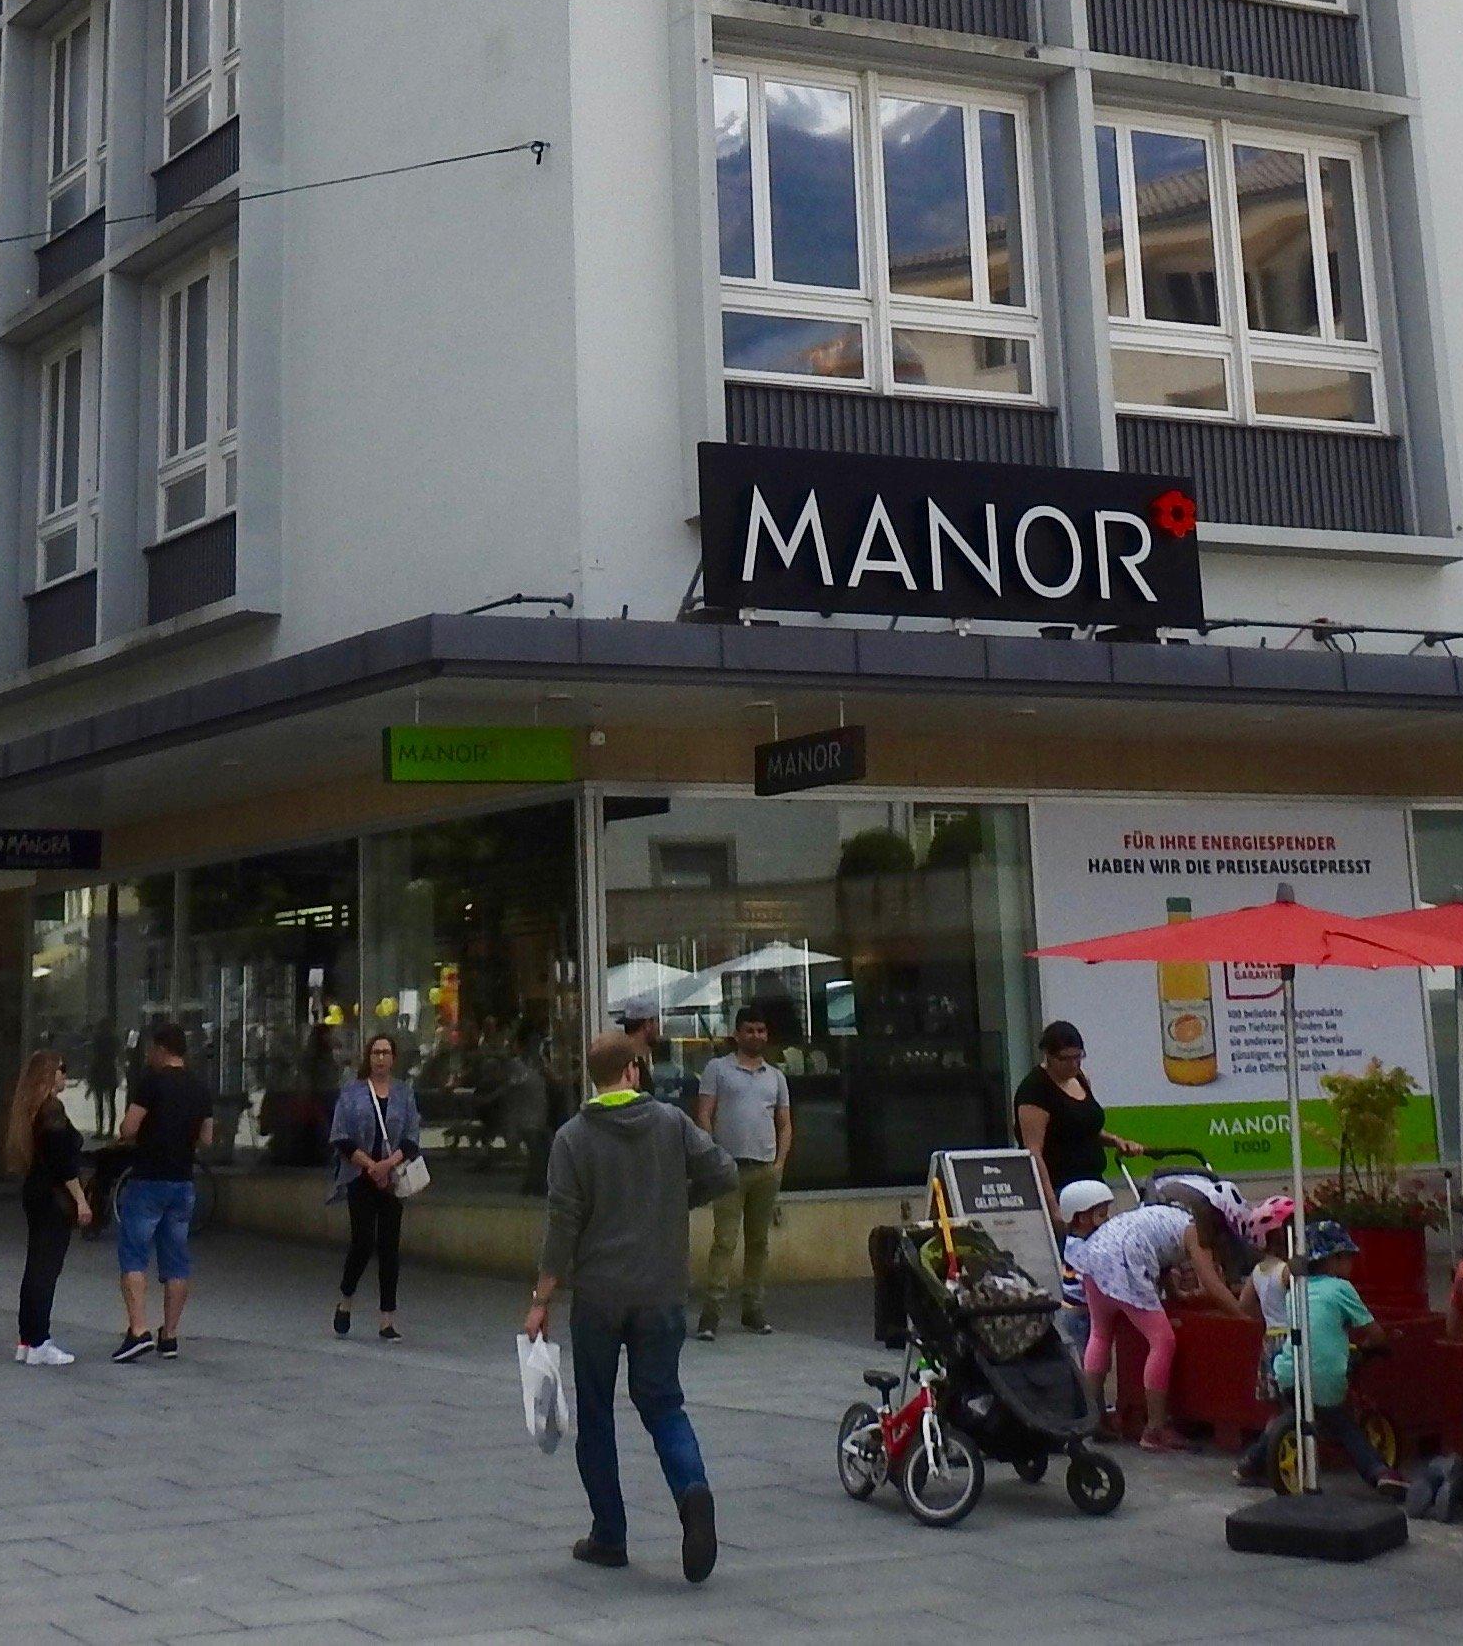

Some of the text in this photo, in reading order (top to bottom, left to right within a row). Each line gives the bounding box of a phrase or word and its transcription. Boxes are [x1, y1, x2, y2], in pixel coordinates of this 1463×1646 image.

[742, 483, 1159, 602] MANOR
[398, 743, 489, 764] MANOR
[767, 741, 841, 779] MANOR
[1124, 830, 1336, 851] FÜR IHRE ENERGIESPENDER
[1088, 858, 1145, 874] HABEN
[1150, 859, 1182, 874] WIR
[1186, 859, 1212, 874] DIE
[1209, 1114, 1292, 1136] MANOR
